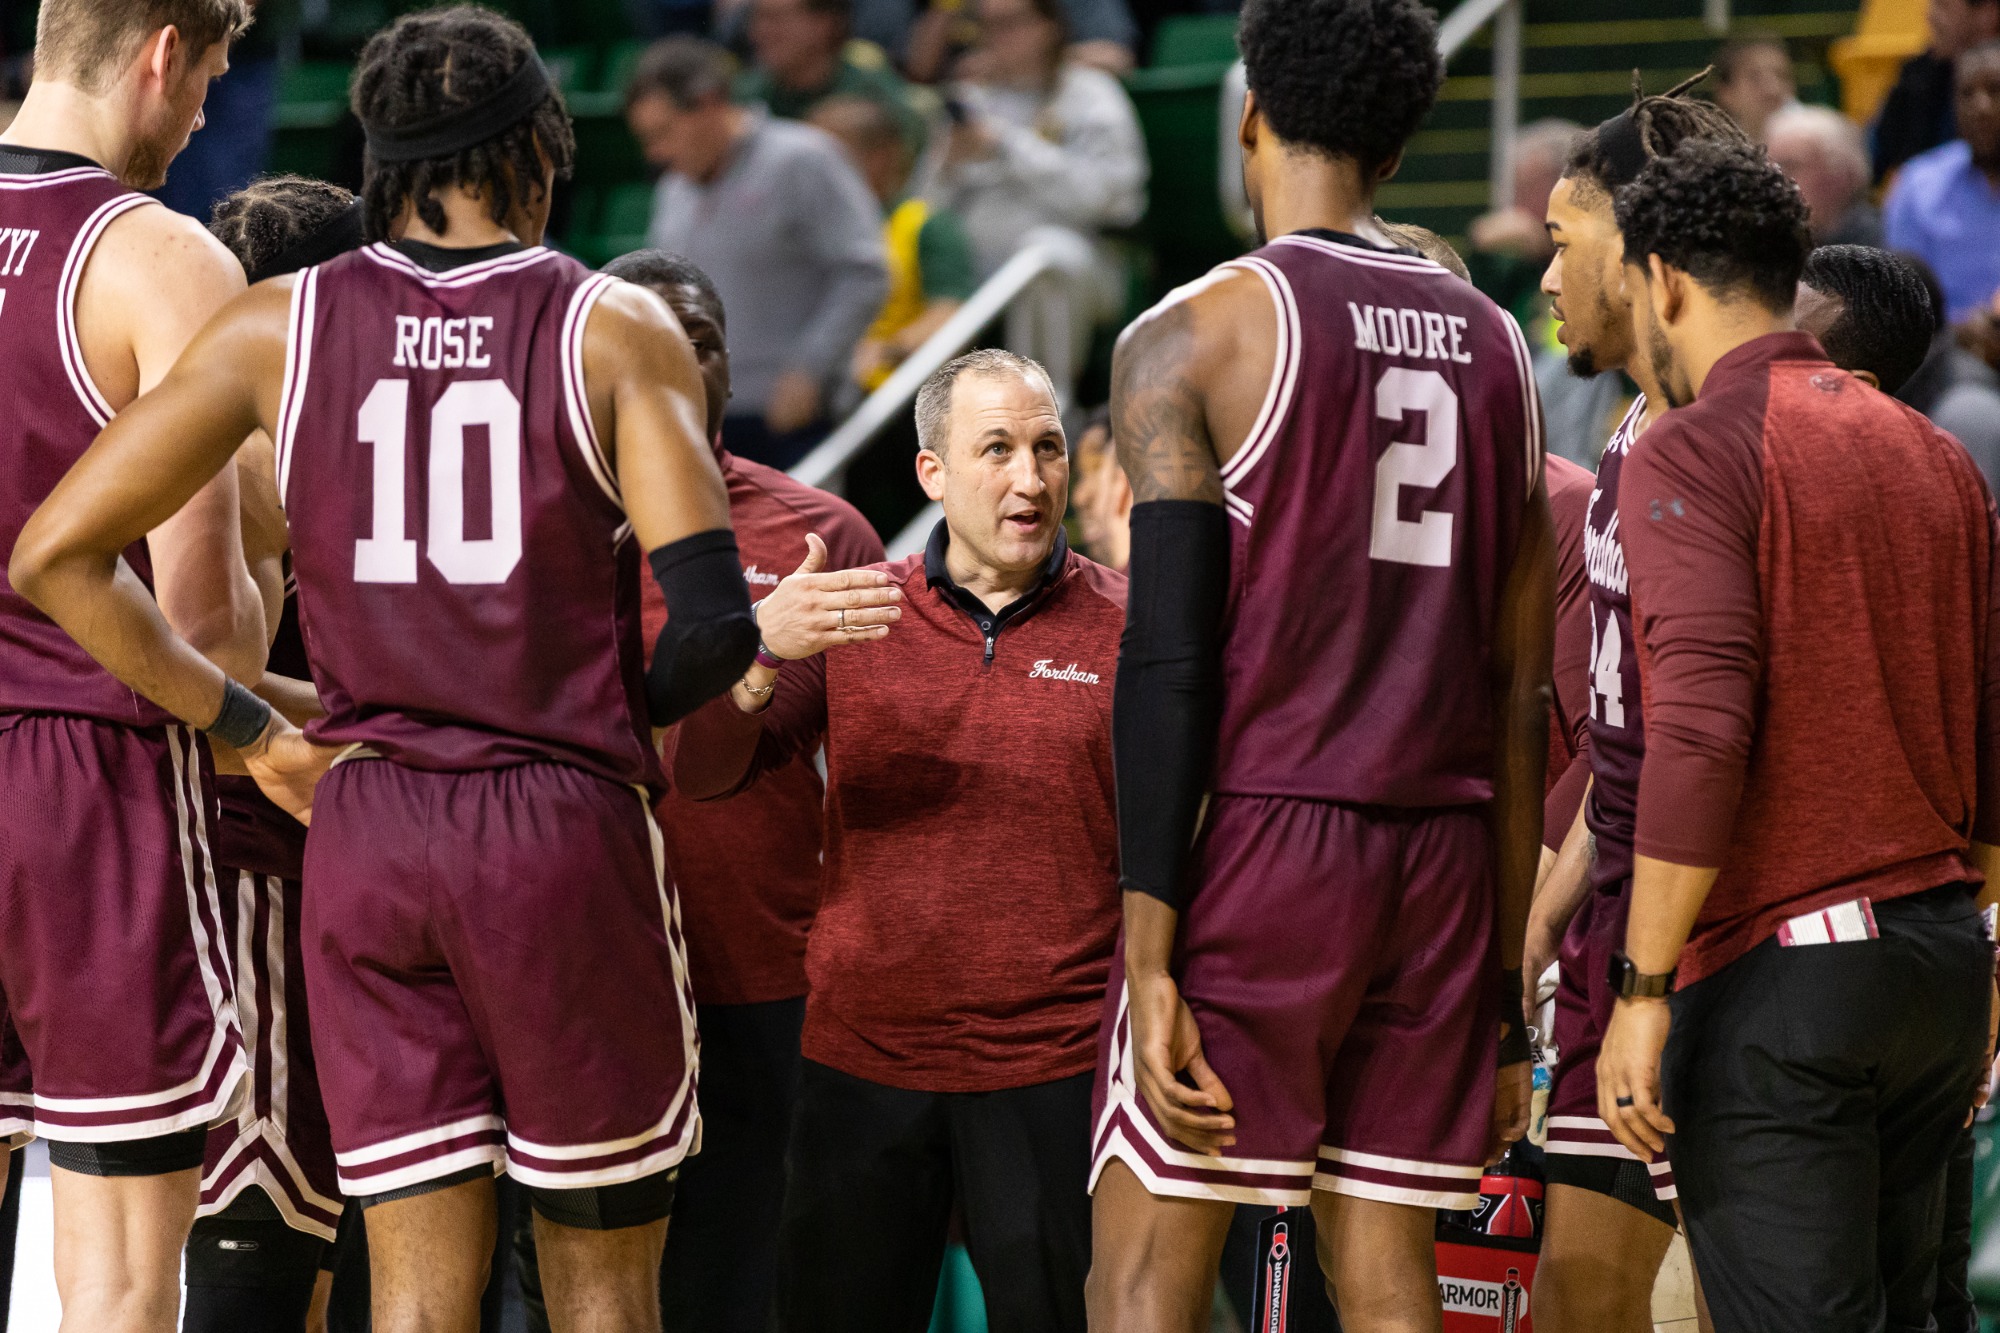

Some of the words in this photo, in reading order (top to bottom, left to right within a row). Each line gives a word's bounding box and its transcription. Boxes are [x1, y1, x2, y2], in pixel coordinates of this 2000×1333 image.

[393, 314, 494, 370] ROSE
[1347, 301, 1472, 364] MOORE
[353, 378, 523, 584] 10
[1368, 366, 1458, 567] 2
[1028, 659, 1100, 685] Fordham
[1270, 1261, 1282, 1333] BODYARMOR
[1439, 1282, 1500, 1310] ARMOR
